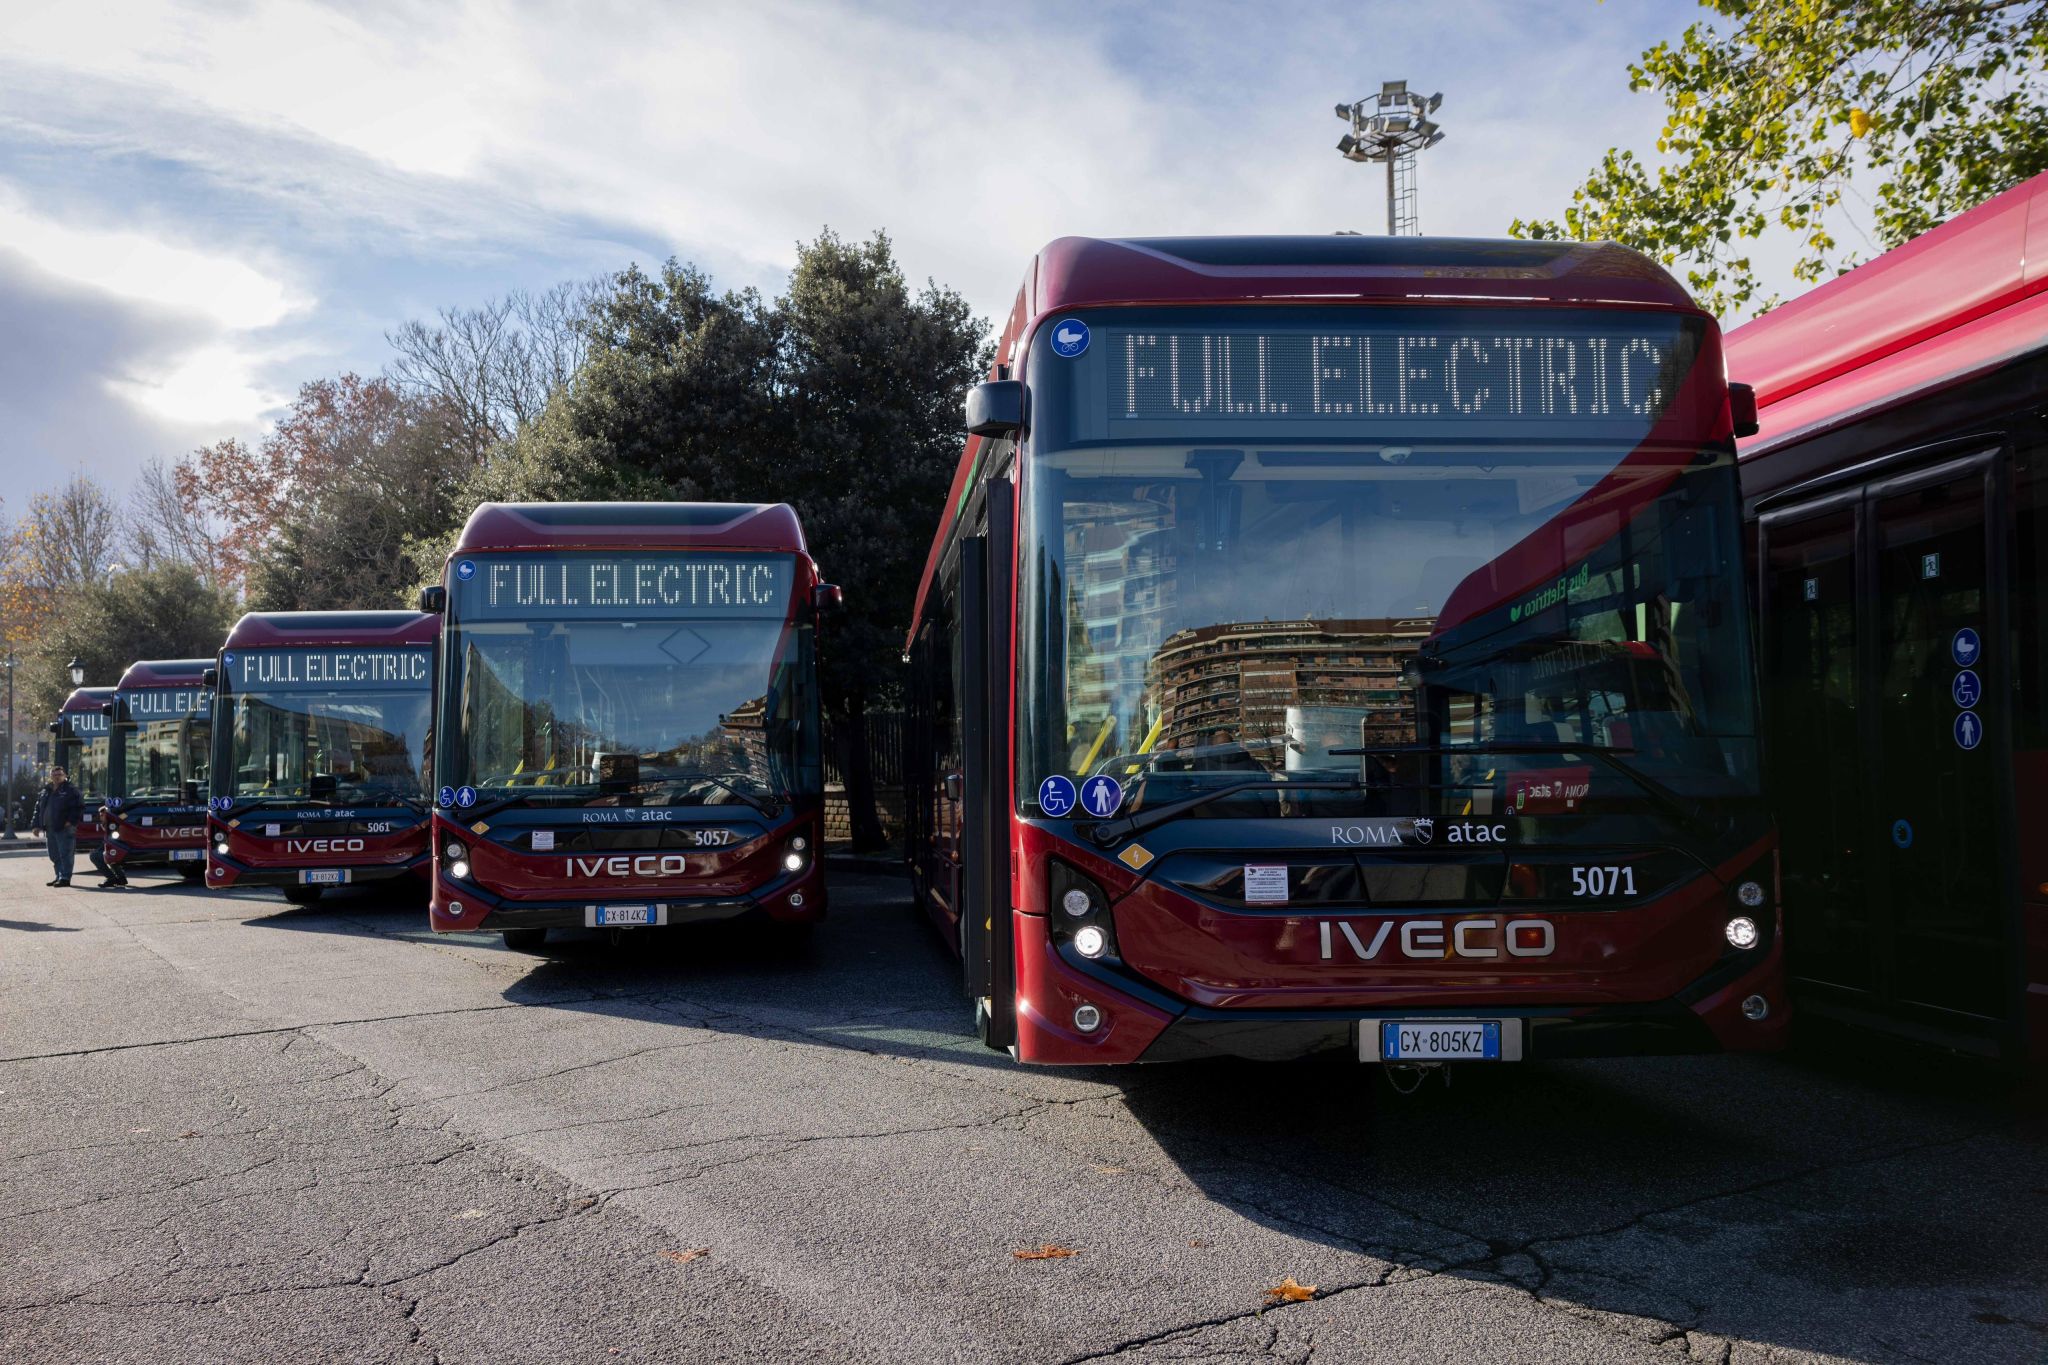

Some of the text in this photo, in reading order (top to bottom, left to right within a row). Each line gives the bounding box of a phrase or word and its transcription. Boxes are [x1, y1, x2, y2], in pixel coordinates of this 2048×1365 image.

[1126, 334, 1664, 415] FULL ELECTRIC
[489, 564, 773, 605] FULL ELECTRIC
[243, 654, 426, 683] FULL ELECTRIC
[129, 691, 216, 714] FULL ELE
[71, 714, 108, 732] FULL
[297, 809, 355, 819] ROMA atac
[582, 809, 672, 823] ROMA atac
[367, 822, 391, 833] 5061
[695, 830, 729, 846] 5057
[1331, 826, 1403, 844] ROMA
[1447, 821, 1507, 843] atac
[287, 838, 364, 853] IVECO
[566, 855, 686, 878] IVECO
[1571, 866, 1638, 896] 5071
[1319, 919, 1556, 961] IVECO
